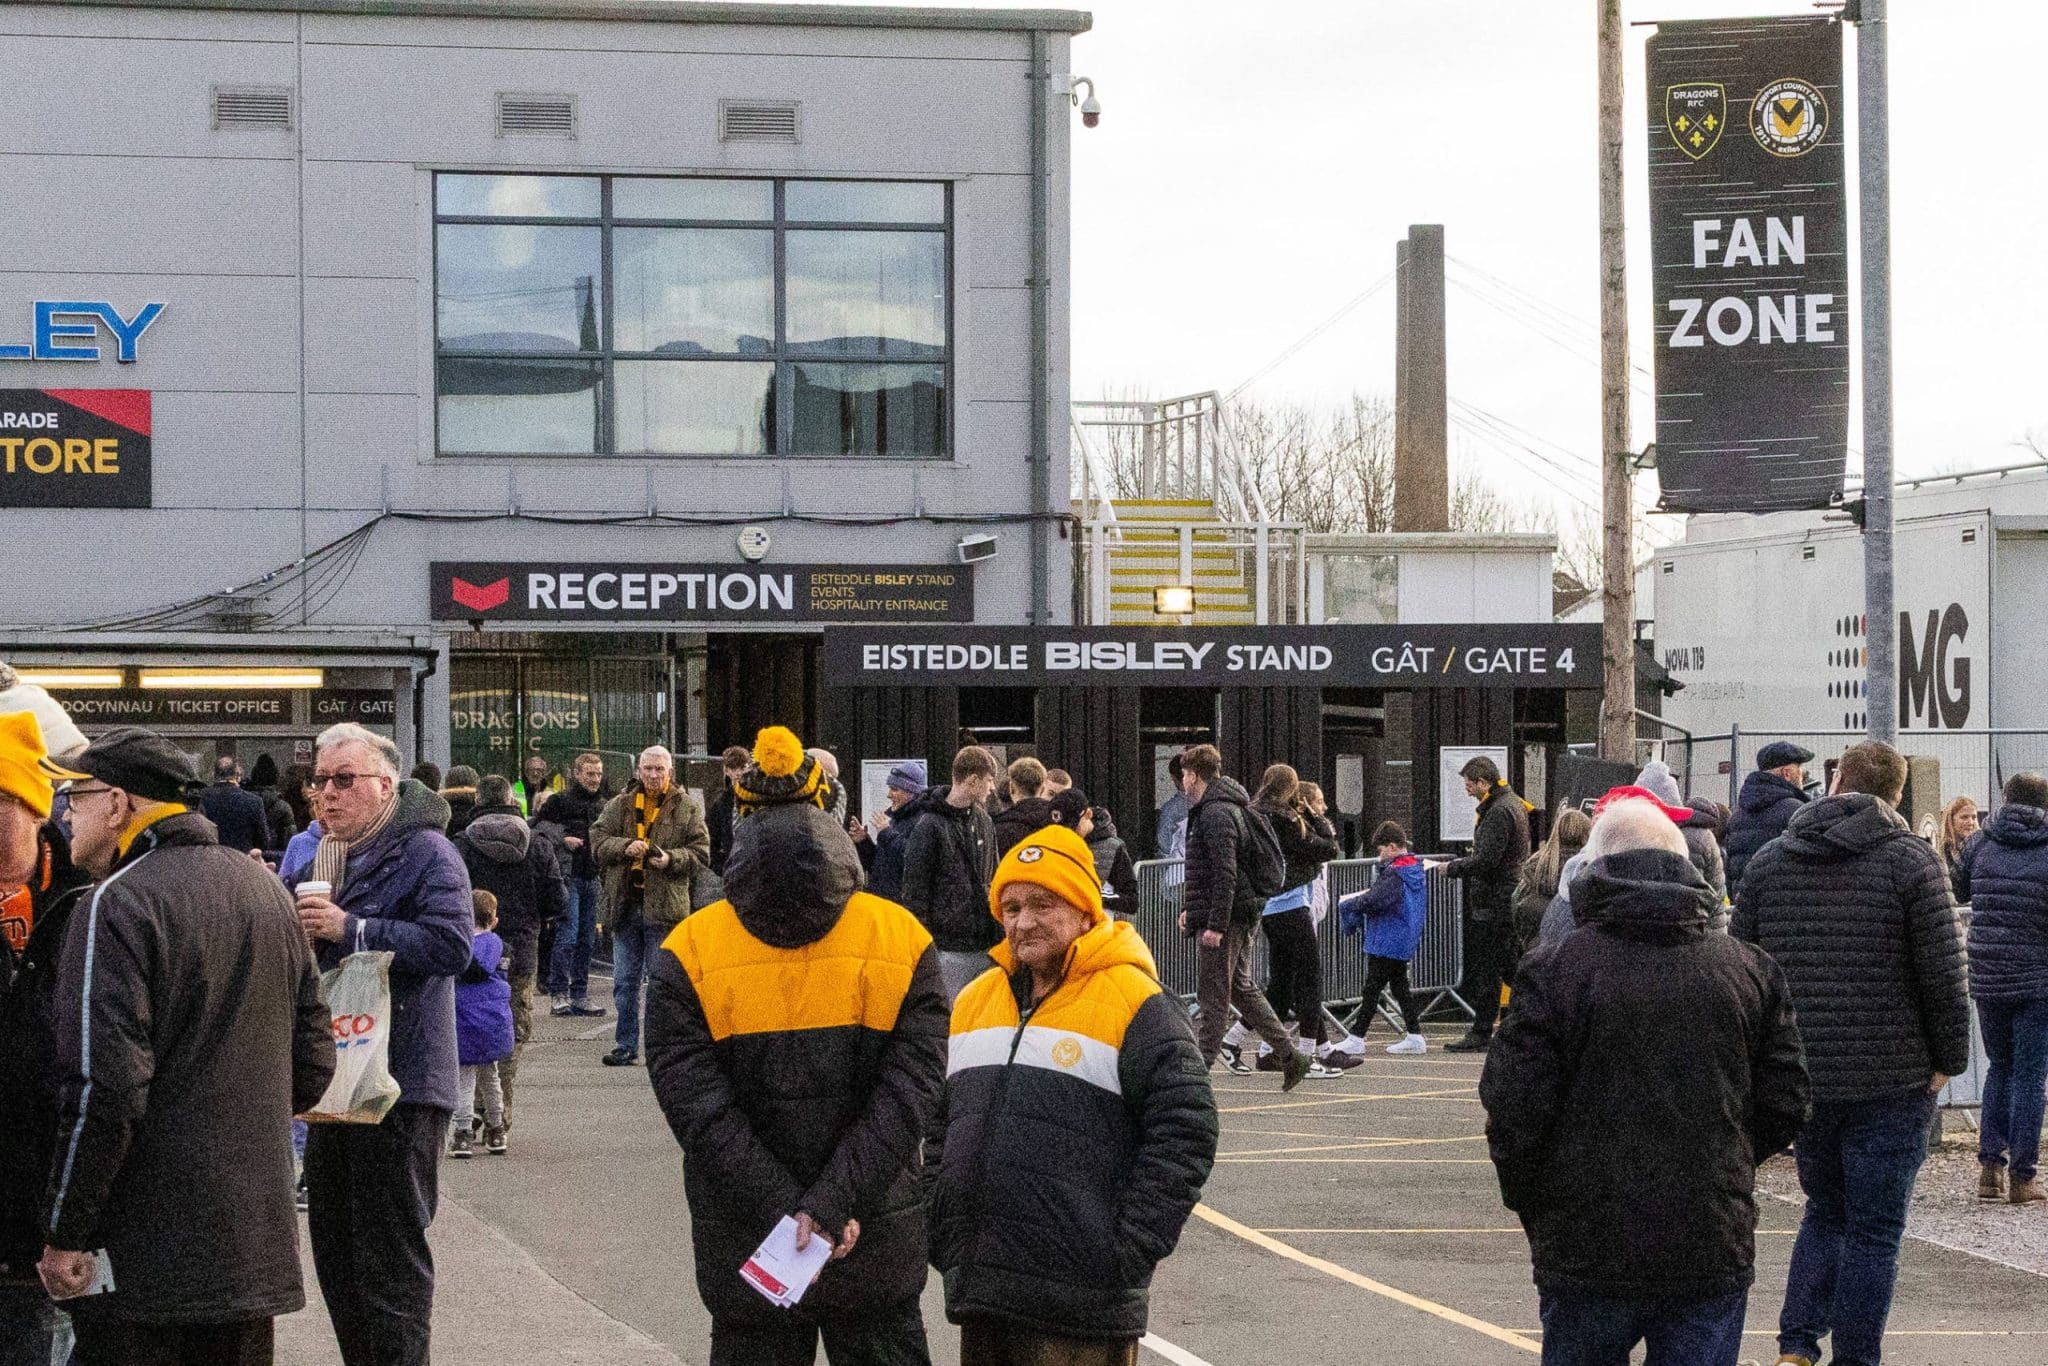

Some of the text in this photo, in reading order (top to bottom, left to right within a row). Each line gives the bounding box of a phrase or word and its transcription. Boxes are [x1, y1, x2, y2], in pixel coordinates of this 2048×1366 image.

[1673, 89, 1719, 99] DRAGONS
[1783, 83, 1812, 95] COUNTY
[1755, 124, 1770, 145] 1912
[1693, 215, 1805, 268] FAN
[1669, 294, 1835, 347] ZONE
[811, 574, 955, 586] EISTEDDLE BISLEY STAND
[528, 573, 793, 610] RECEPTION
[811, 586, 855, 597] EVENTS
[811, 599, 948, 610] HOSPITALITY ENTRANCE
[863, 645, 1028, 670] EISTEDDLE
[1045, 642, 1216, 670] BISLEY
[1226, 645, 1333, 671] STAND
[1371, 642, 1434, 673] GÂT
[1465, 648, 1546, 673] GATE
[1556, 648, 1575, 673] 4
[1665, 646, 1704, 671] NOVA 119
[1899, 602, 1971, 729] MG
[168, 700, 221, 713] TICKET
[225, 700, 280, 713] OFFICE
[318, 699, 347, 713] GÂT
[454, 711, 580, 729] DRAGONS
[332, 1014, 375, 1038] CO
